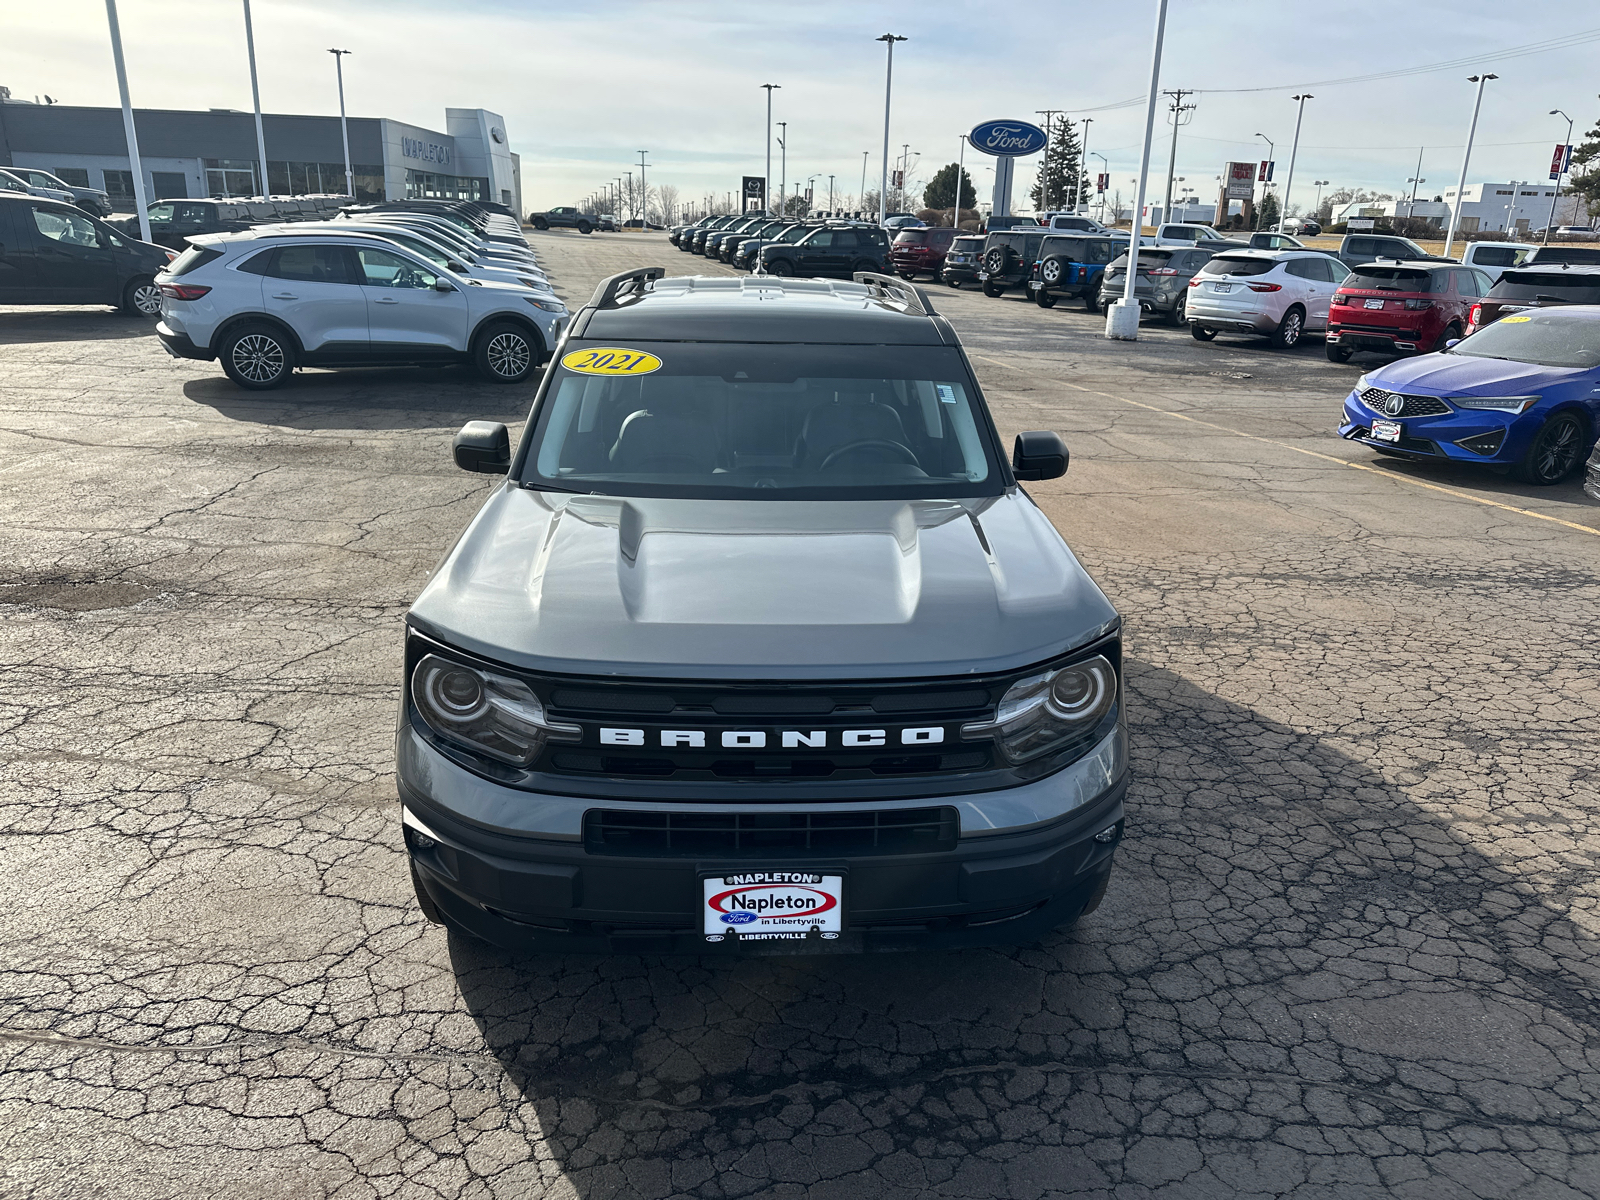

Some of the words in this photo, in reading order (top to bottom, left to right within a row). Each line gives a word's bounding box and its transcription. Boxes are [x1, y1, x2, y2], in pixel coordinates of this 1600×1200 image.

[987, 126, 1032, 149] Ford
[402, 136, 450, 165] NAPLETON
[573, 353, 647, 370] 2021
[600, 726, 944, 748] BRONCO
[732, 873, 814, 885] NAPLETON
[731, 894, 816, 913] Napleton
[727, 913, 751, 923] Ford
[739, 933, 807, 941] LIBERTYVILLE
